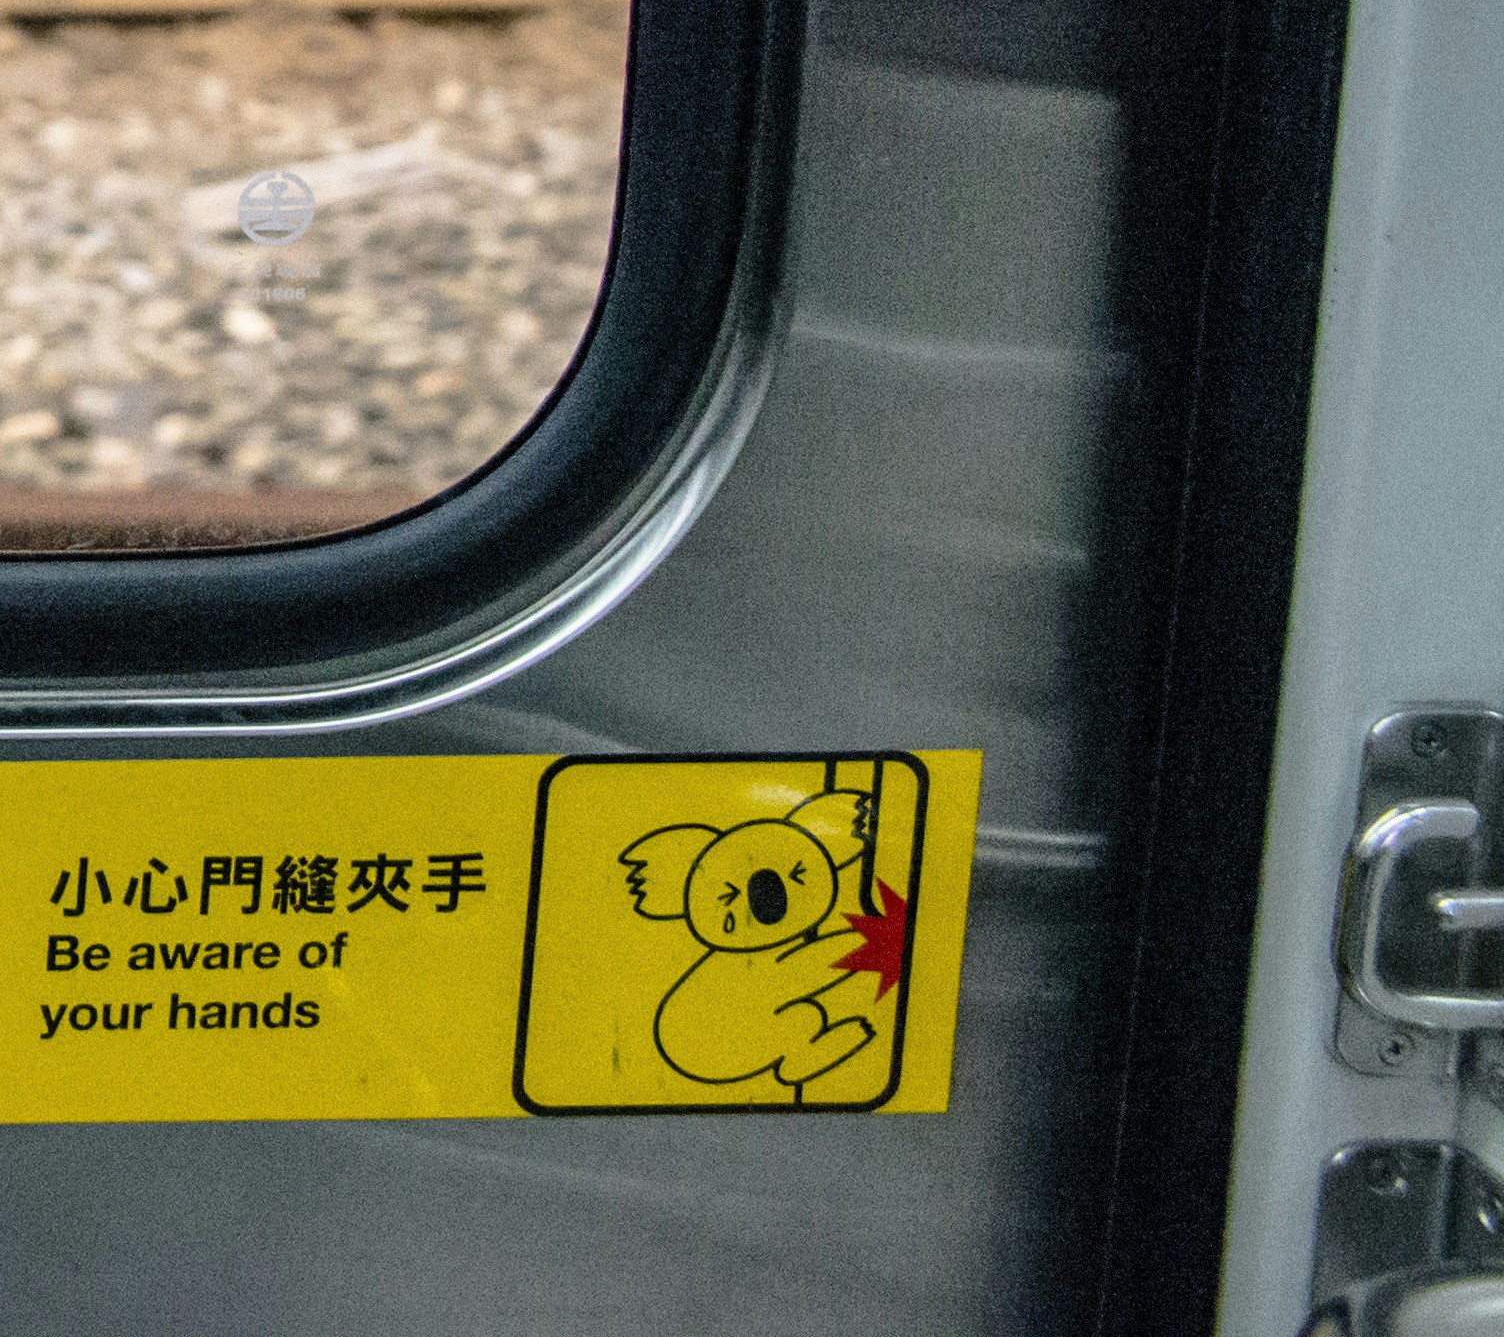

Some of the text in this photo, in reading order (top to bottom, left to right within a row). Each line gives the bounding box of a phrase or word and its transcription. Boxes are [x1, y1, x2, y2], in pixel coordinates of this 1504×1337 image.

[50, 852, 488, 918] 小心門縫夾手
[46, 931, 349, 972] Be aware of
[40, 992, 320, 1040] your hands
